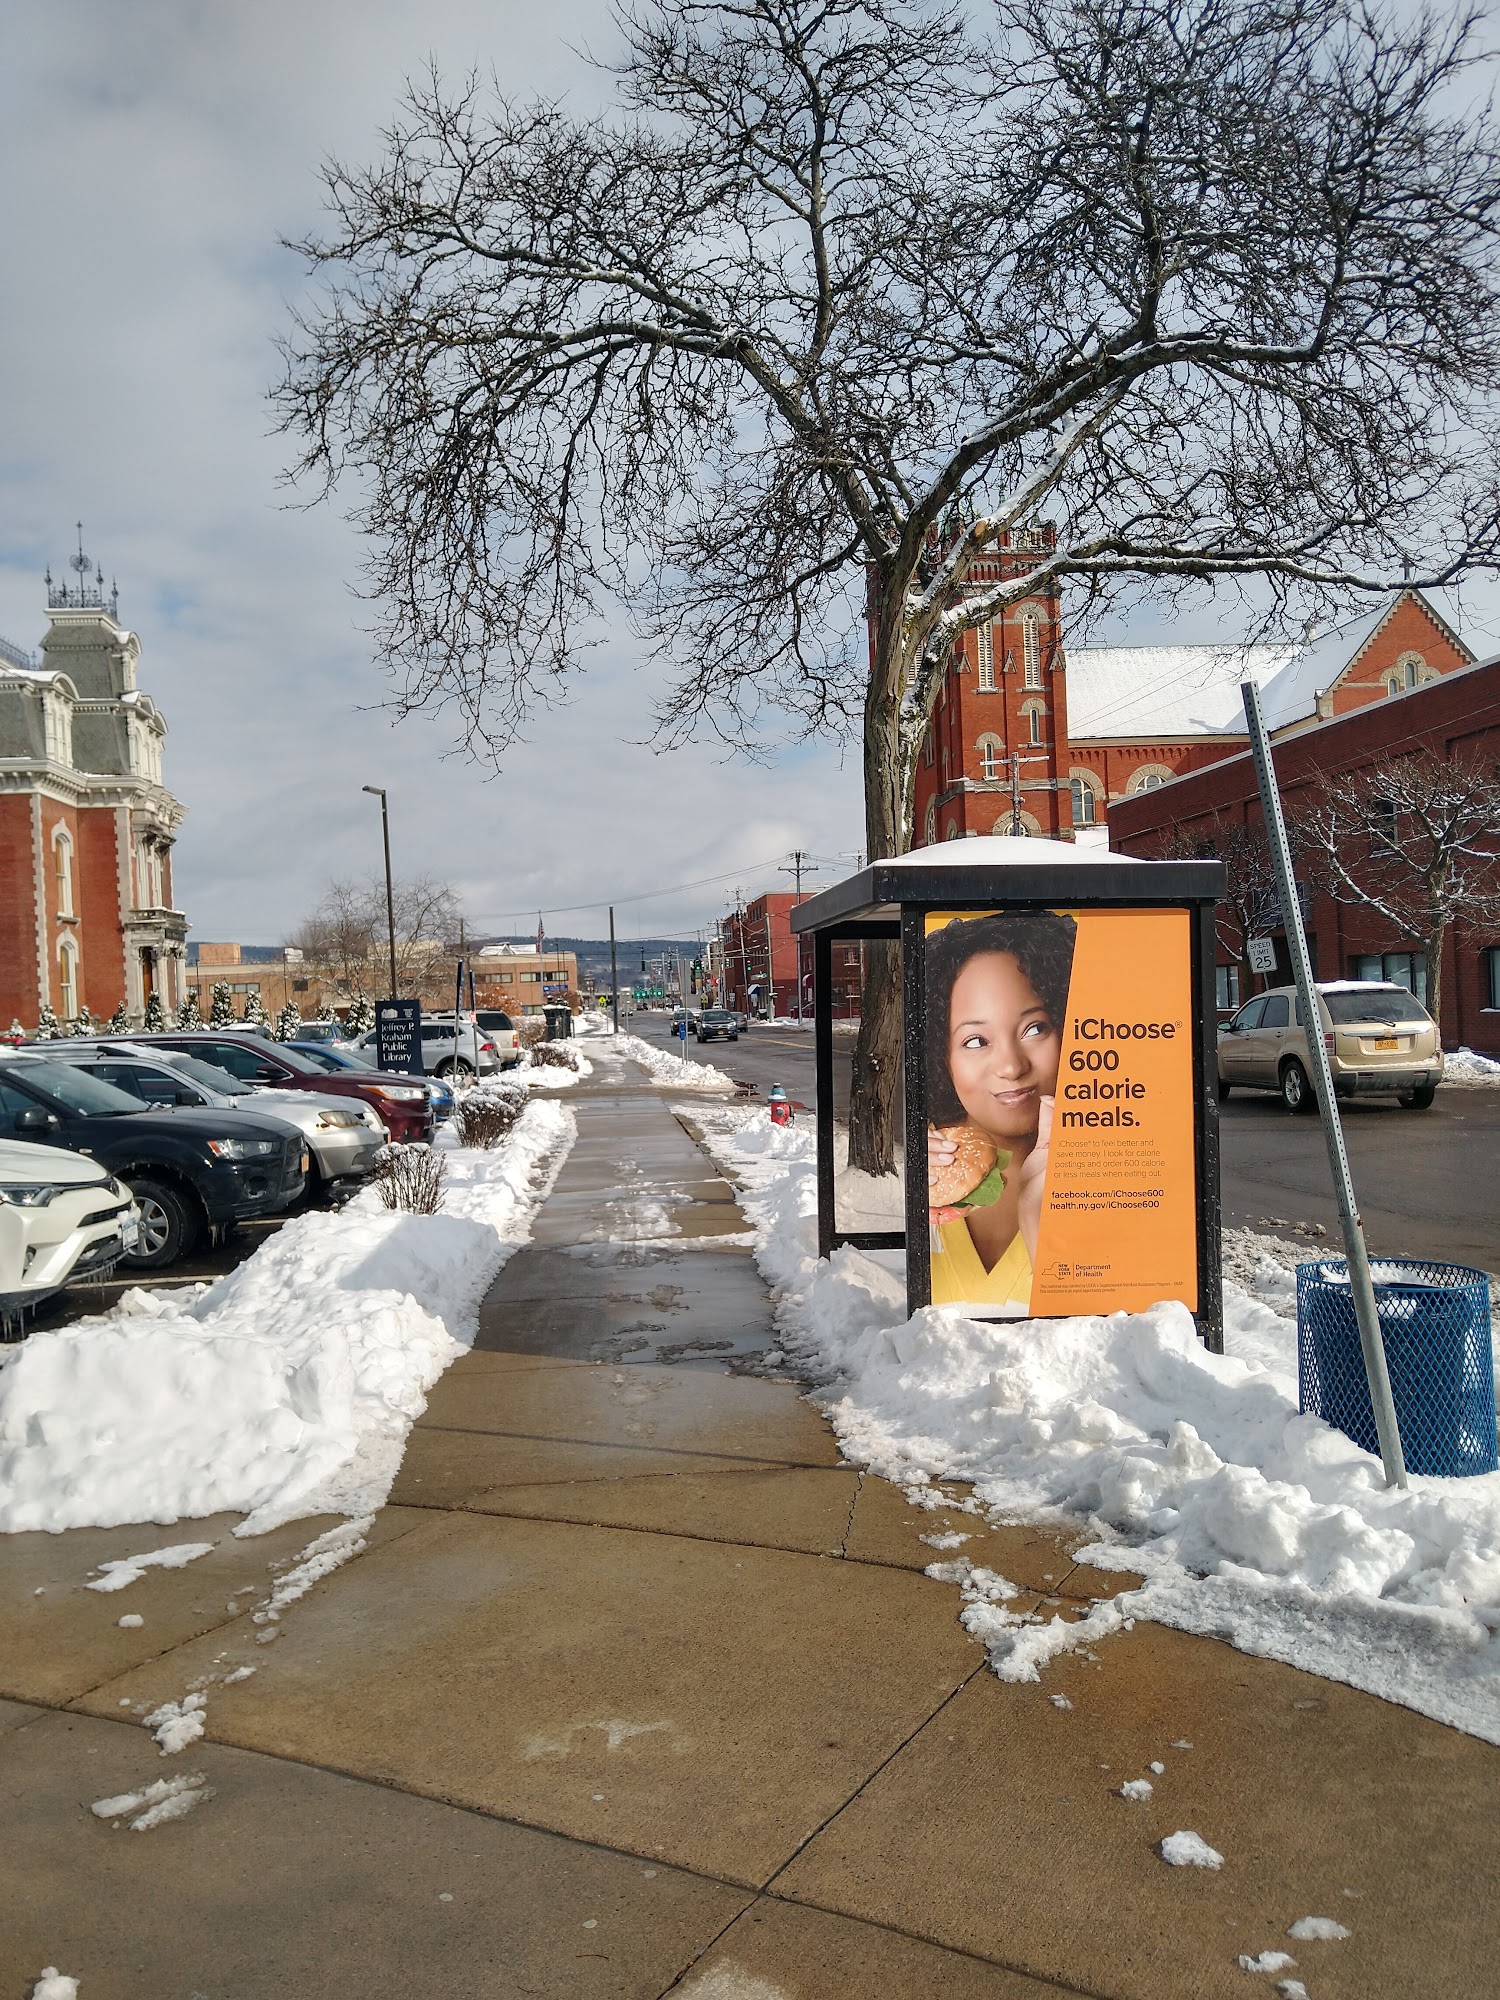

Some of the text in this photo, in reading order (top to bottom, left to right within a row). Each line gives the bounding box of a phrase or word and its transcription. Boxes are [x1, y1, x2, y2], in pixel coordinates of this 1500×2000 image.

[1256, 956, 1271, 968] 25
[382, 1022, 415, 1033] Jeffrey P.
[381, 1032, 412, 1042] Kraham
[383, 1042, 407, 1051] Public
[383, 1052, 411, 1062] Library
[1069, 1050, 1120, 1071] 600
[1064, 1077, 1146, 1100] calorie
[1062, 1105, 1141, 1128] meals.
[1092, 1140, 1101, 1148] to
[1101, 1139, 1116, 1147] feel
[1116, 1139, 1139, 1147] better
[1140, 1138, 1154, 1147] and
[1107, 1149, 1124, 1157] look
[1124, 1149, 1135, 1157] for
[1136, 1149, 1161, 1157] calorie
[1054, 1159, 1166, 1170] postings and order 600 calorie
[1063, 1170, 1078, 1178] less
[1079, 1170, 1101, 1178] meals
[1101, 1170, 1123, 1178] when
[1124, 1170, 1147, 1179] eating
[1051, 1189, 1165, 1199] facebook.com/iChoose600
[1050, 1200, 1160, 1211] health.ny.gov/iChoose600
